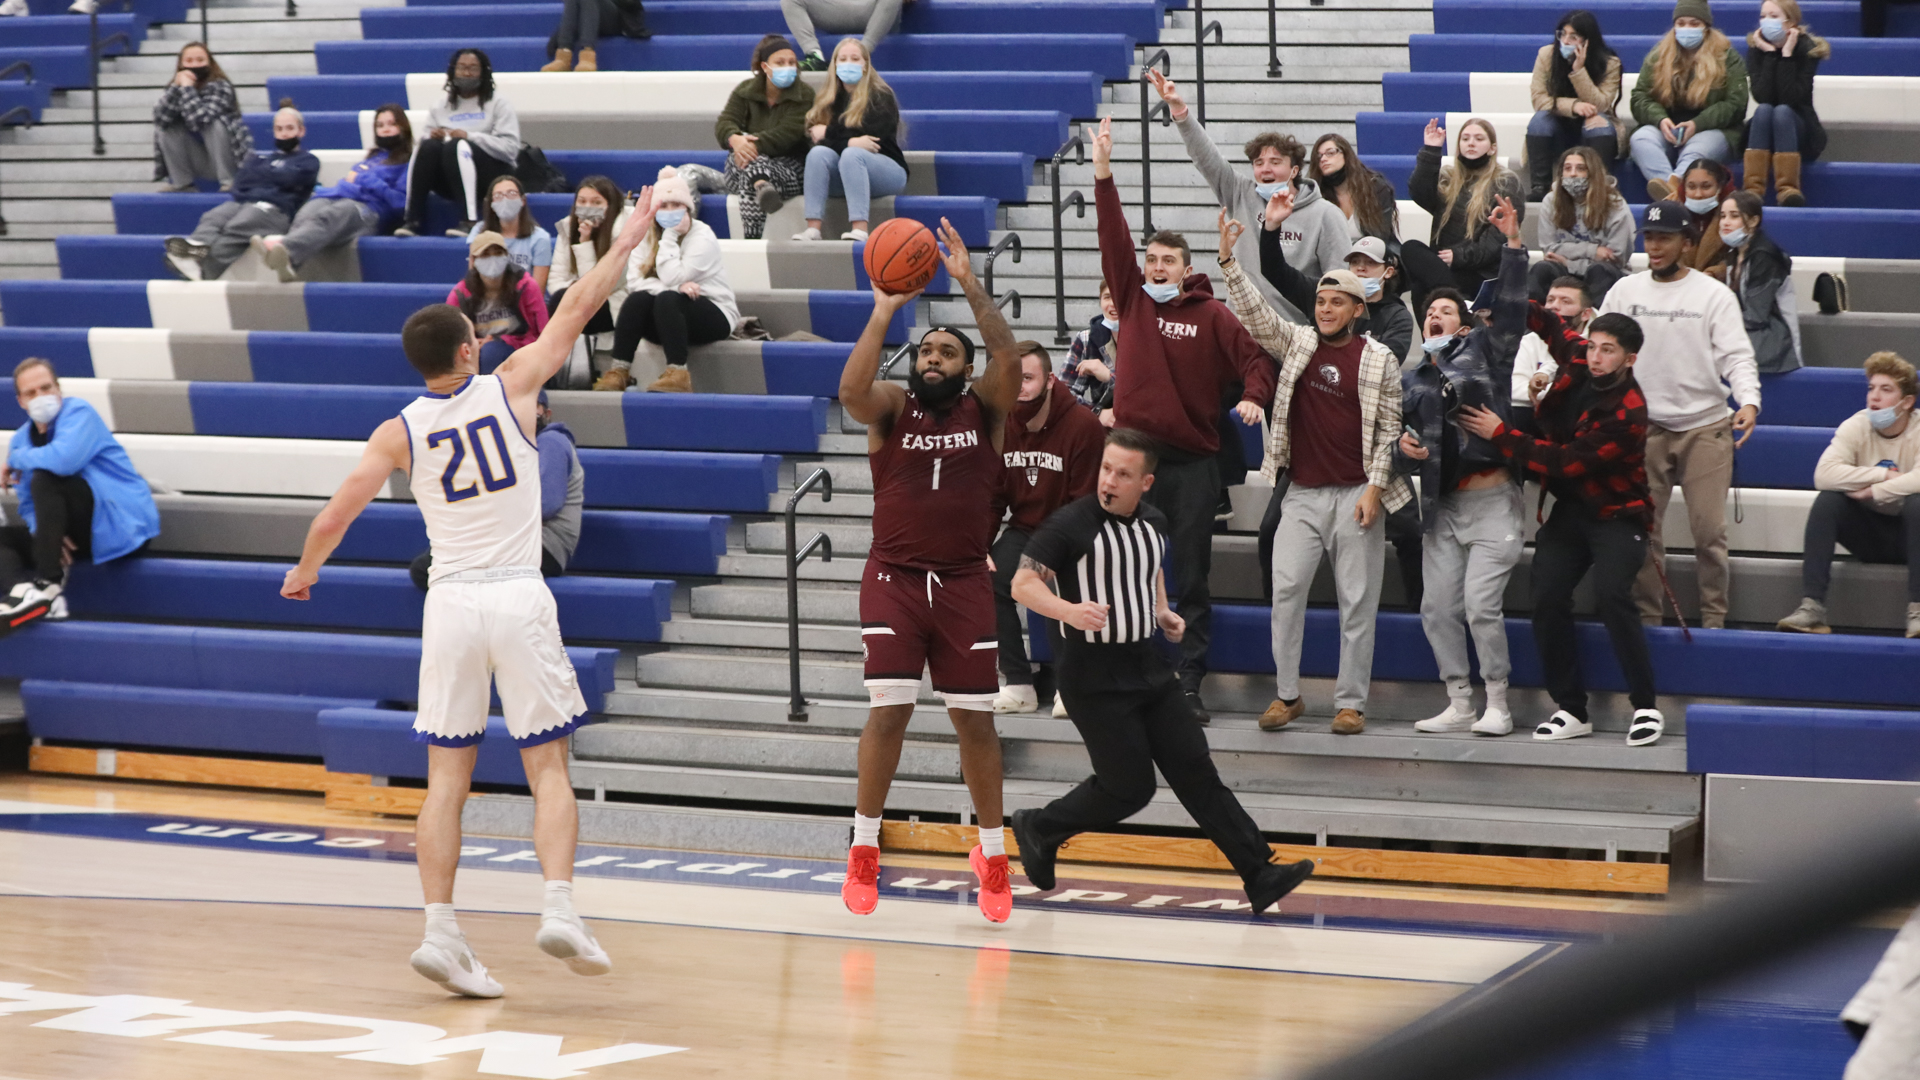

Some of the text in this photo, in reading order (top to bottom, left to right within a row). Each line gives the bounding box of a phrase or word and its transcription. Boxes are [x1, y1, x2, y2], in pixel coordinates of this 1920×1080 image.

[1627, 304, 1703, 323] Champion
[1310, 380, 1346, 398] BASEBALL
[902, 430, 979, 450] EASTERN
[426, 413, 517, 504] 20
[1003, 450, 1064, 472] EASTERN
[932, 458, 942, 490] 1
